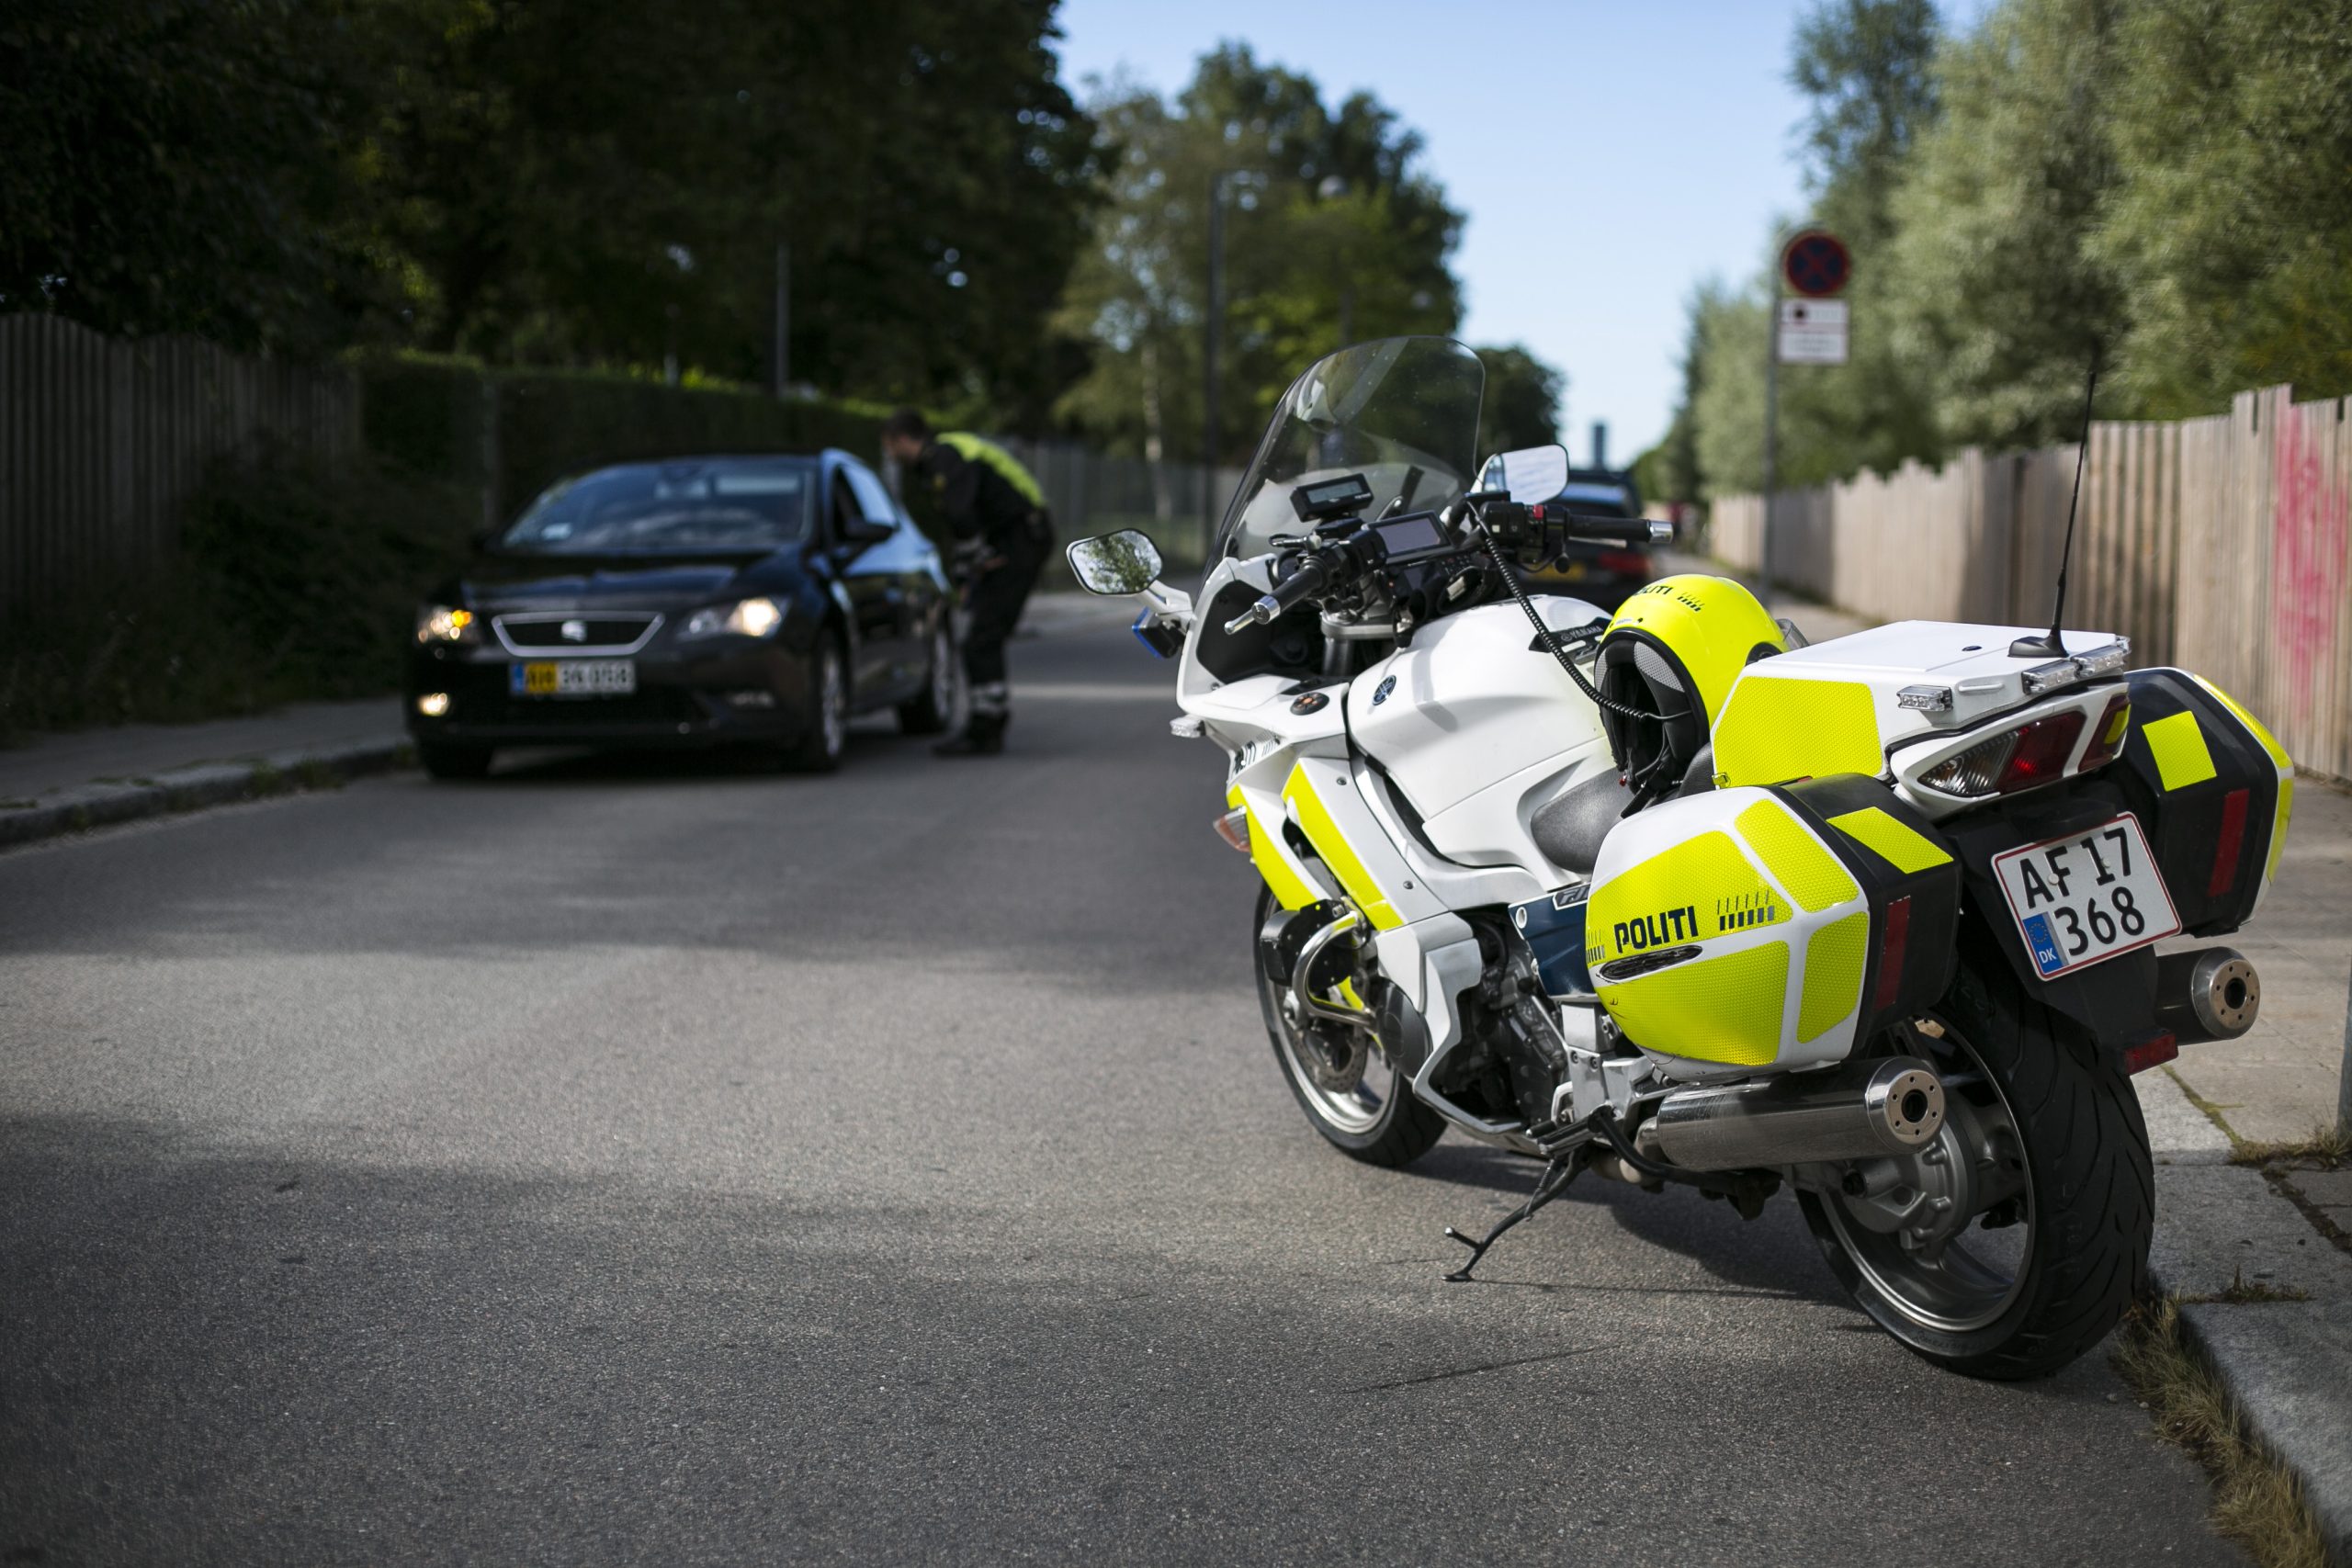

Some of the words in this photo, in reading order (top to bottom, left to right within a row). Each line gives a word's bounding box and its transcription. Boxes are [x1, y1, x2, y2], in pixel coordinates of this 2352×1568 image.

[2019, 846, 2071, 909] AF
[2079, 827, 2132, 886] 17
[1614, 906, 1698, 953] POLITI
[2054, 886, 2145, 956] 368
[2038, 947, 2056, 964] DK
